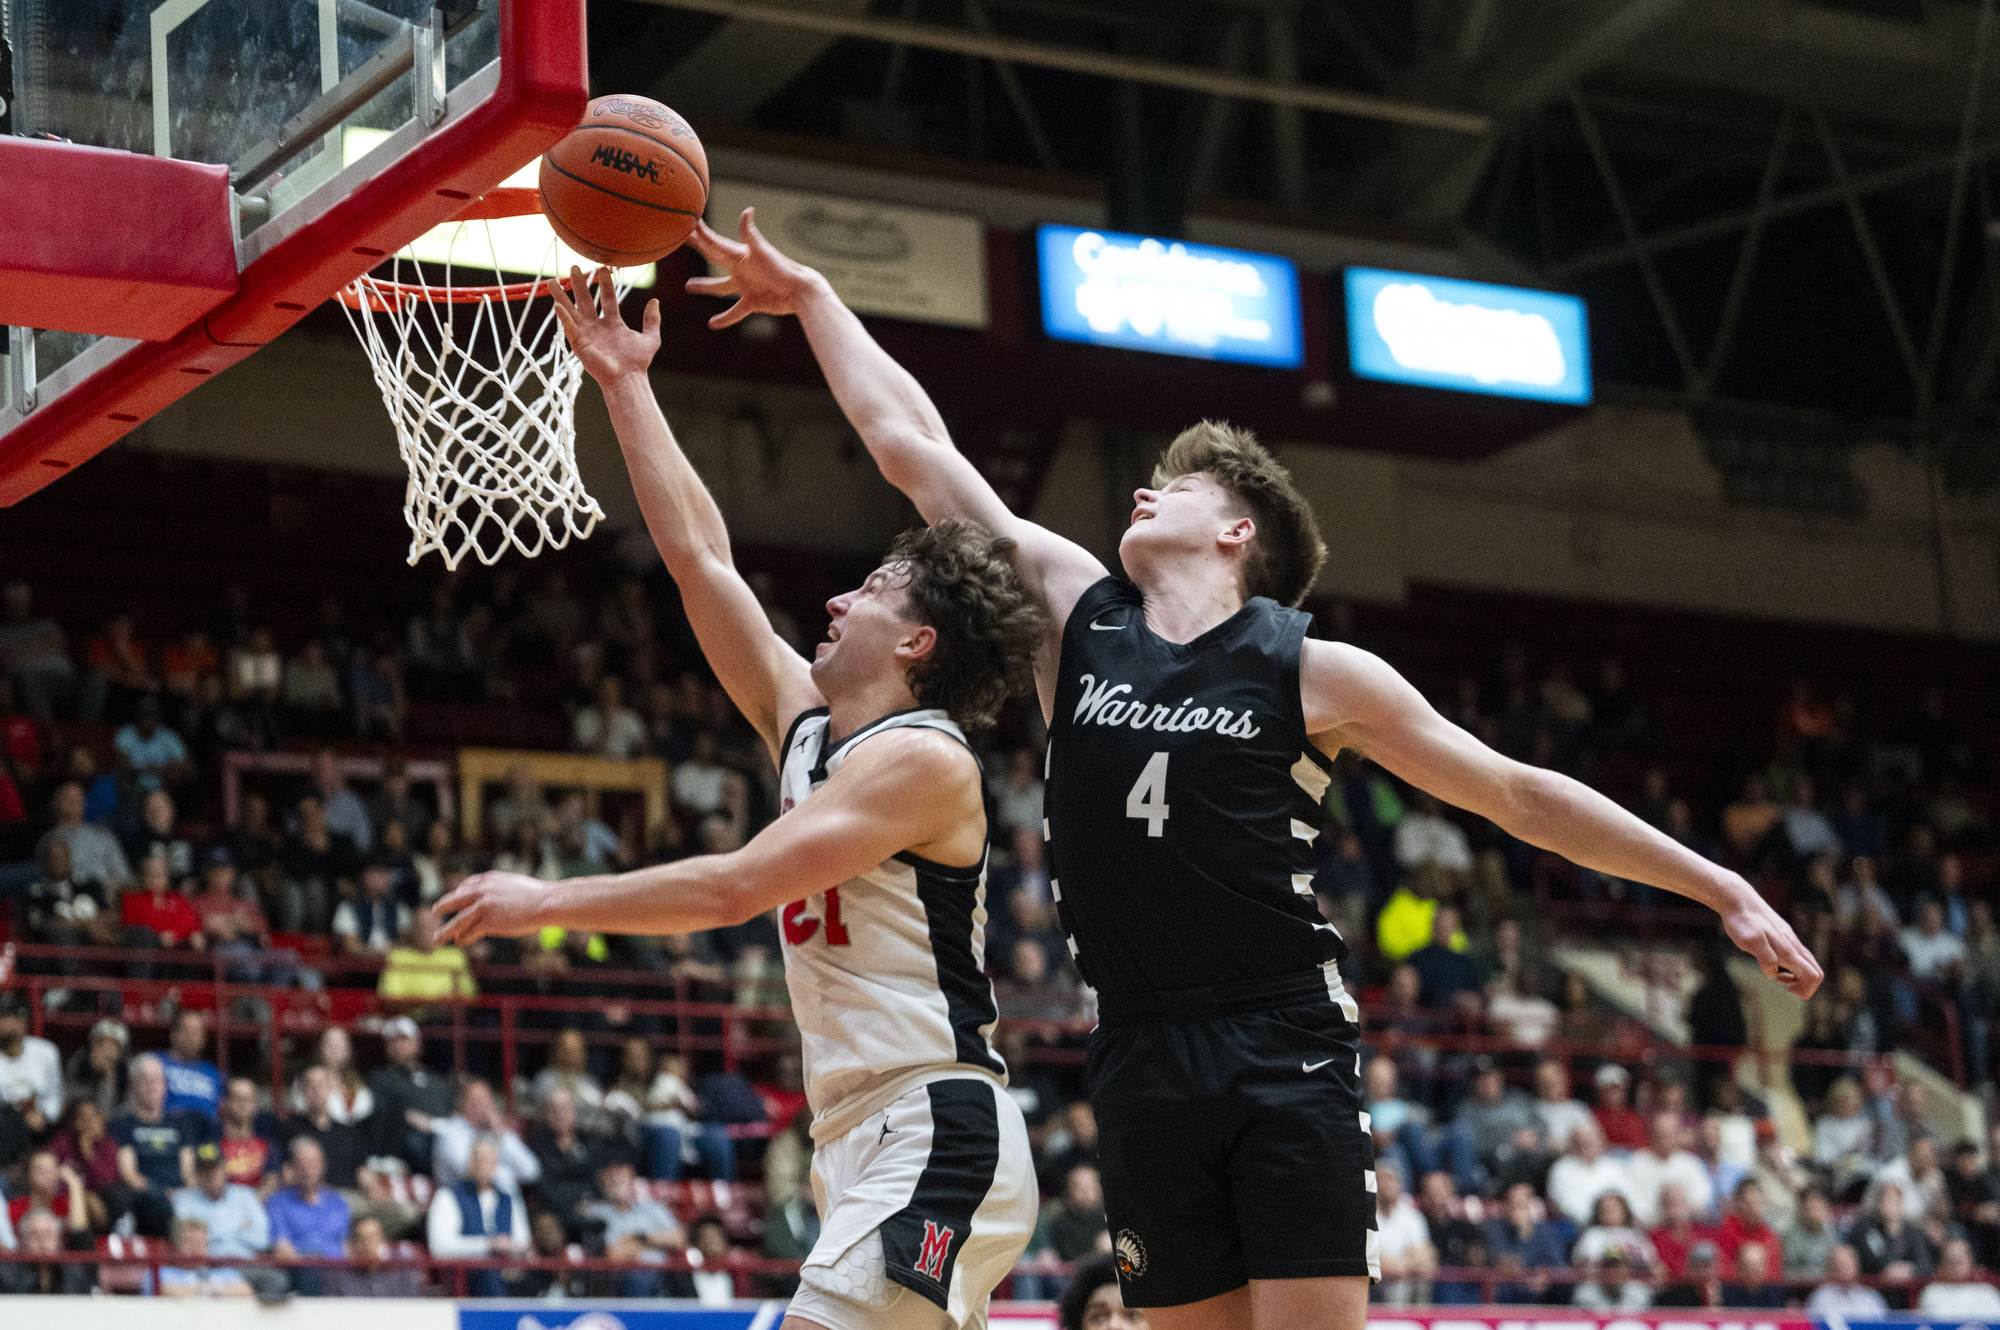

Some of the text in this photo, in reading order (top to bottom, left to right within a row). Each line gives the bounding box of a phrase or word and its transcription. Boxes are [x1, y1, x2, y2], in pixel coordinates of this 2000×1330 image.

[1073, 674, 1260, 739] Warriors
[1126, 752, 1169, 837] 4
[914, 1220, 954, 1281] M
